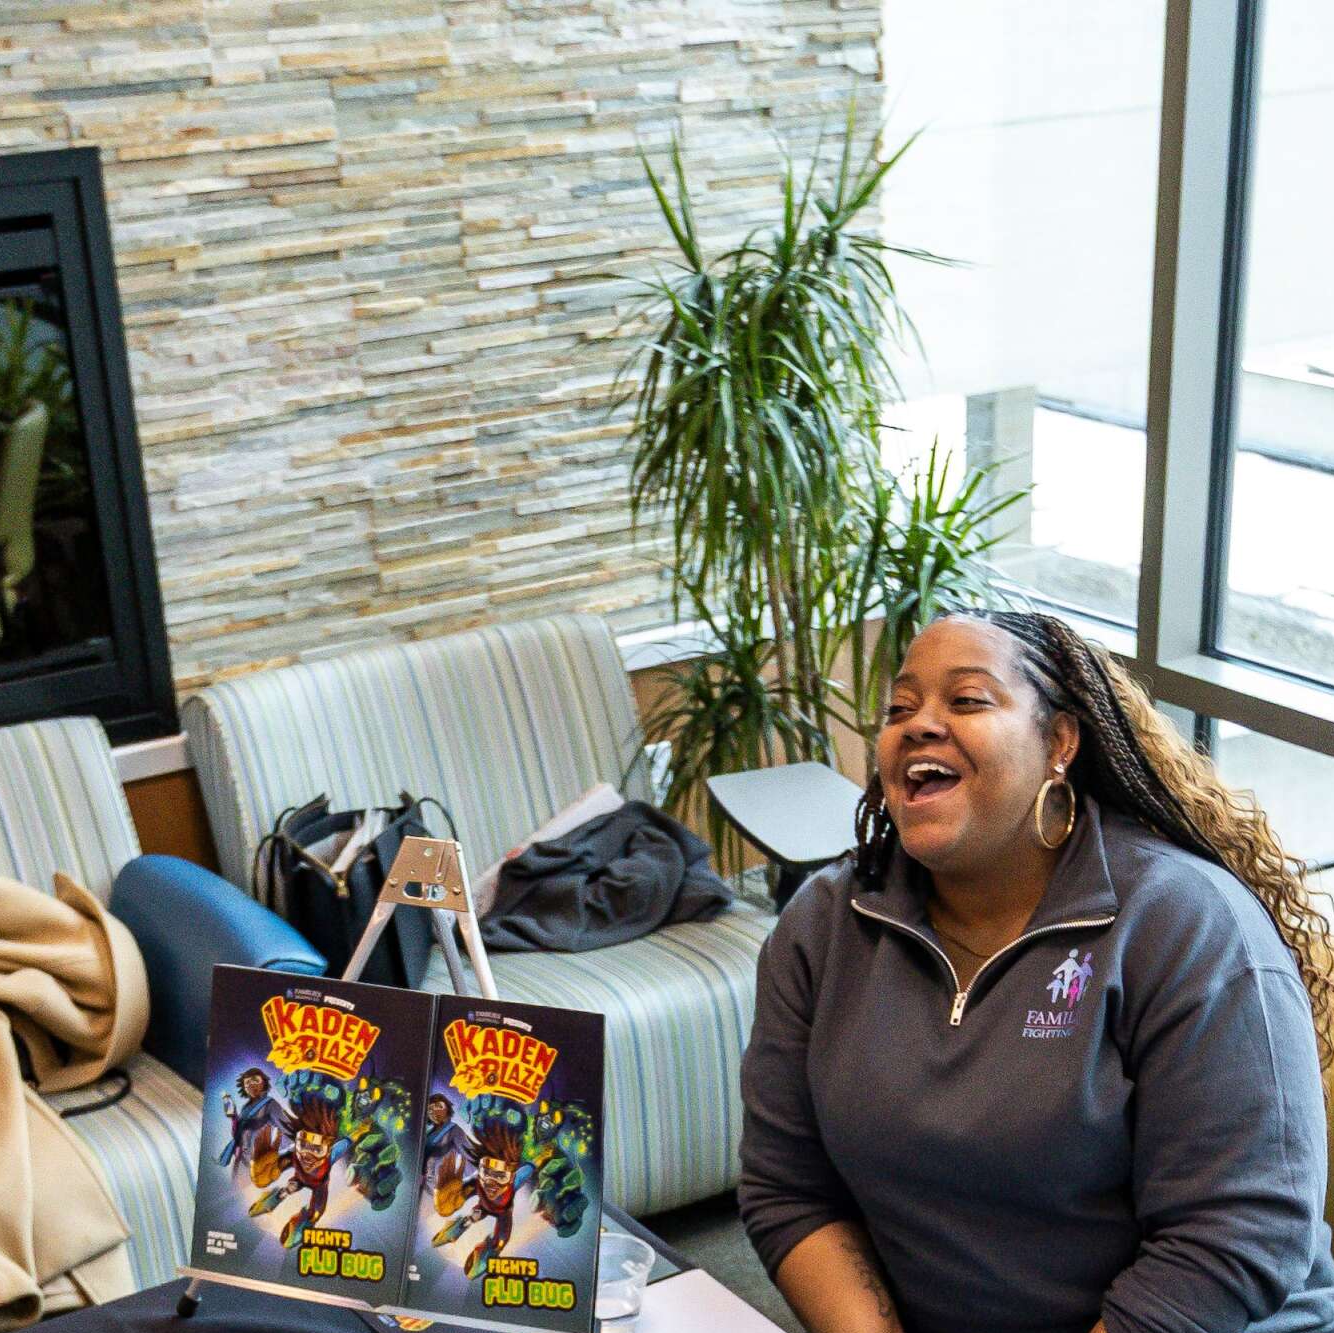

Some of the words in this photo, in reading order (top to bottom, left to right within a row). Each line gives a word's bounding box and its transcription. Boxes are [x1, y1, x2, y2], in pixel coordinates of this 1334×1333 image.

[271, 996, 380, 1052] KADEN
[1022, 1028, 1075, 1038] FIGHTIN
[1028, 1010, 1075, 1026] FAMIL
[295, 1034, 365, 1076] BLAZE
[454, 1020, 557, 1073] KADEN
[477, 1058, 546, 1101] BLAZE
[303, 1230, 351, 1247] FIGHTS
[300, 1247, 338, 1274] FLU
[341, 1252, 384, 1280] BUG
[488, 1258, 537, 1275] FIGHTS
[484, 1276, 524, 1305] FLU
[528, 1281, 575, 1309] BUG
